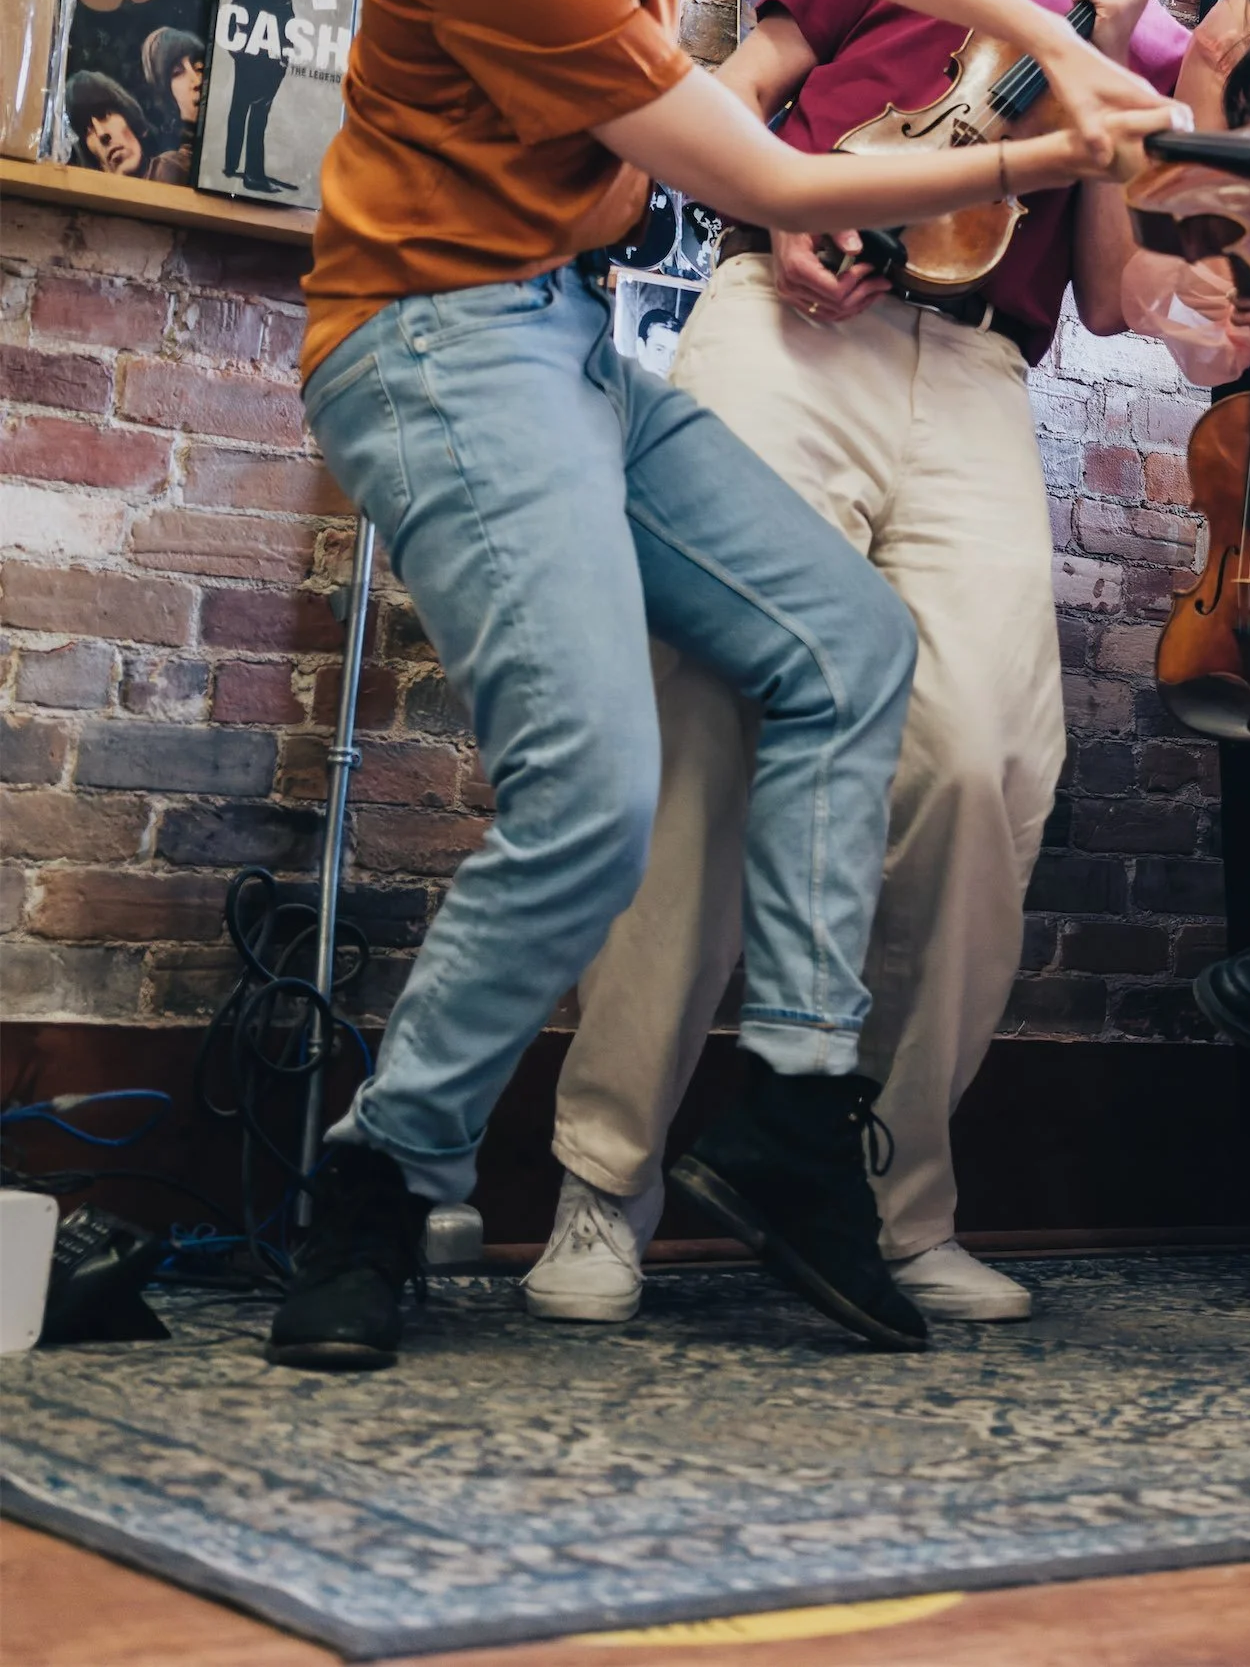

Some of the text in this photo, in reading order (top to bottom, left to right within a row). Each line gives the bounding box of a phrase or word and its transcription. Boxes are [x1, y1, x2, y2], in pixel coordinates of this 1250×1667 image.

[215, 2, 352, 73] CASH
[289, 64, 343, 85] THE LEGEND
